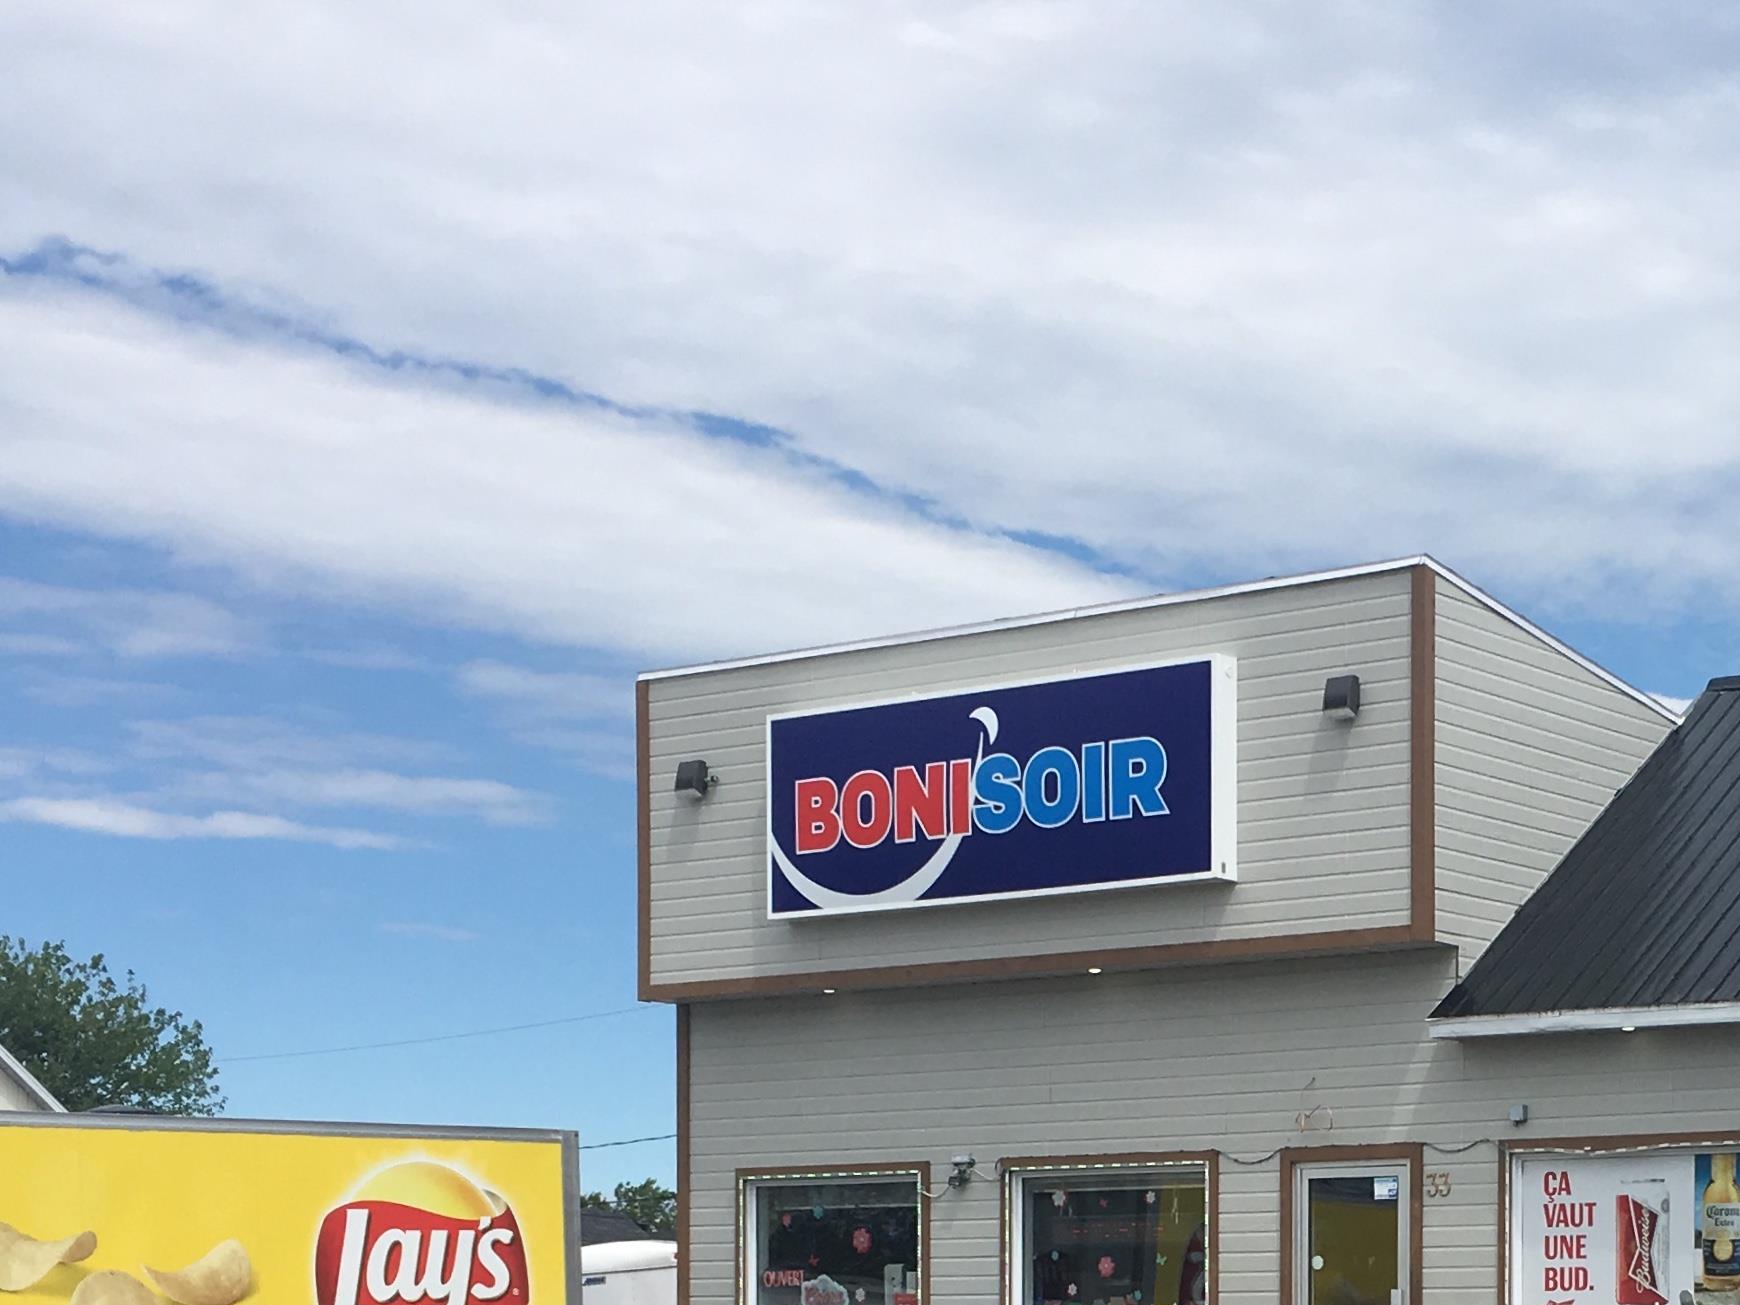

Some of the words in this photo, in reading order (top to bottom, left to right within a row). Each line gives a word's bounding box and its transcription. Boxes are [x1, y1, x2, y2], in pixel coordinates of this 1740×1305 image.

[1426, 1172, 1452, 1197] 33
[1543, 1171, 1572, 1203] ÇA
[1543, 1202, 1597, 1228] VAUT
[1543, 1235, 1587, 1260] UNE
[1543, 1267, 1595, 1292] BUD.
